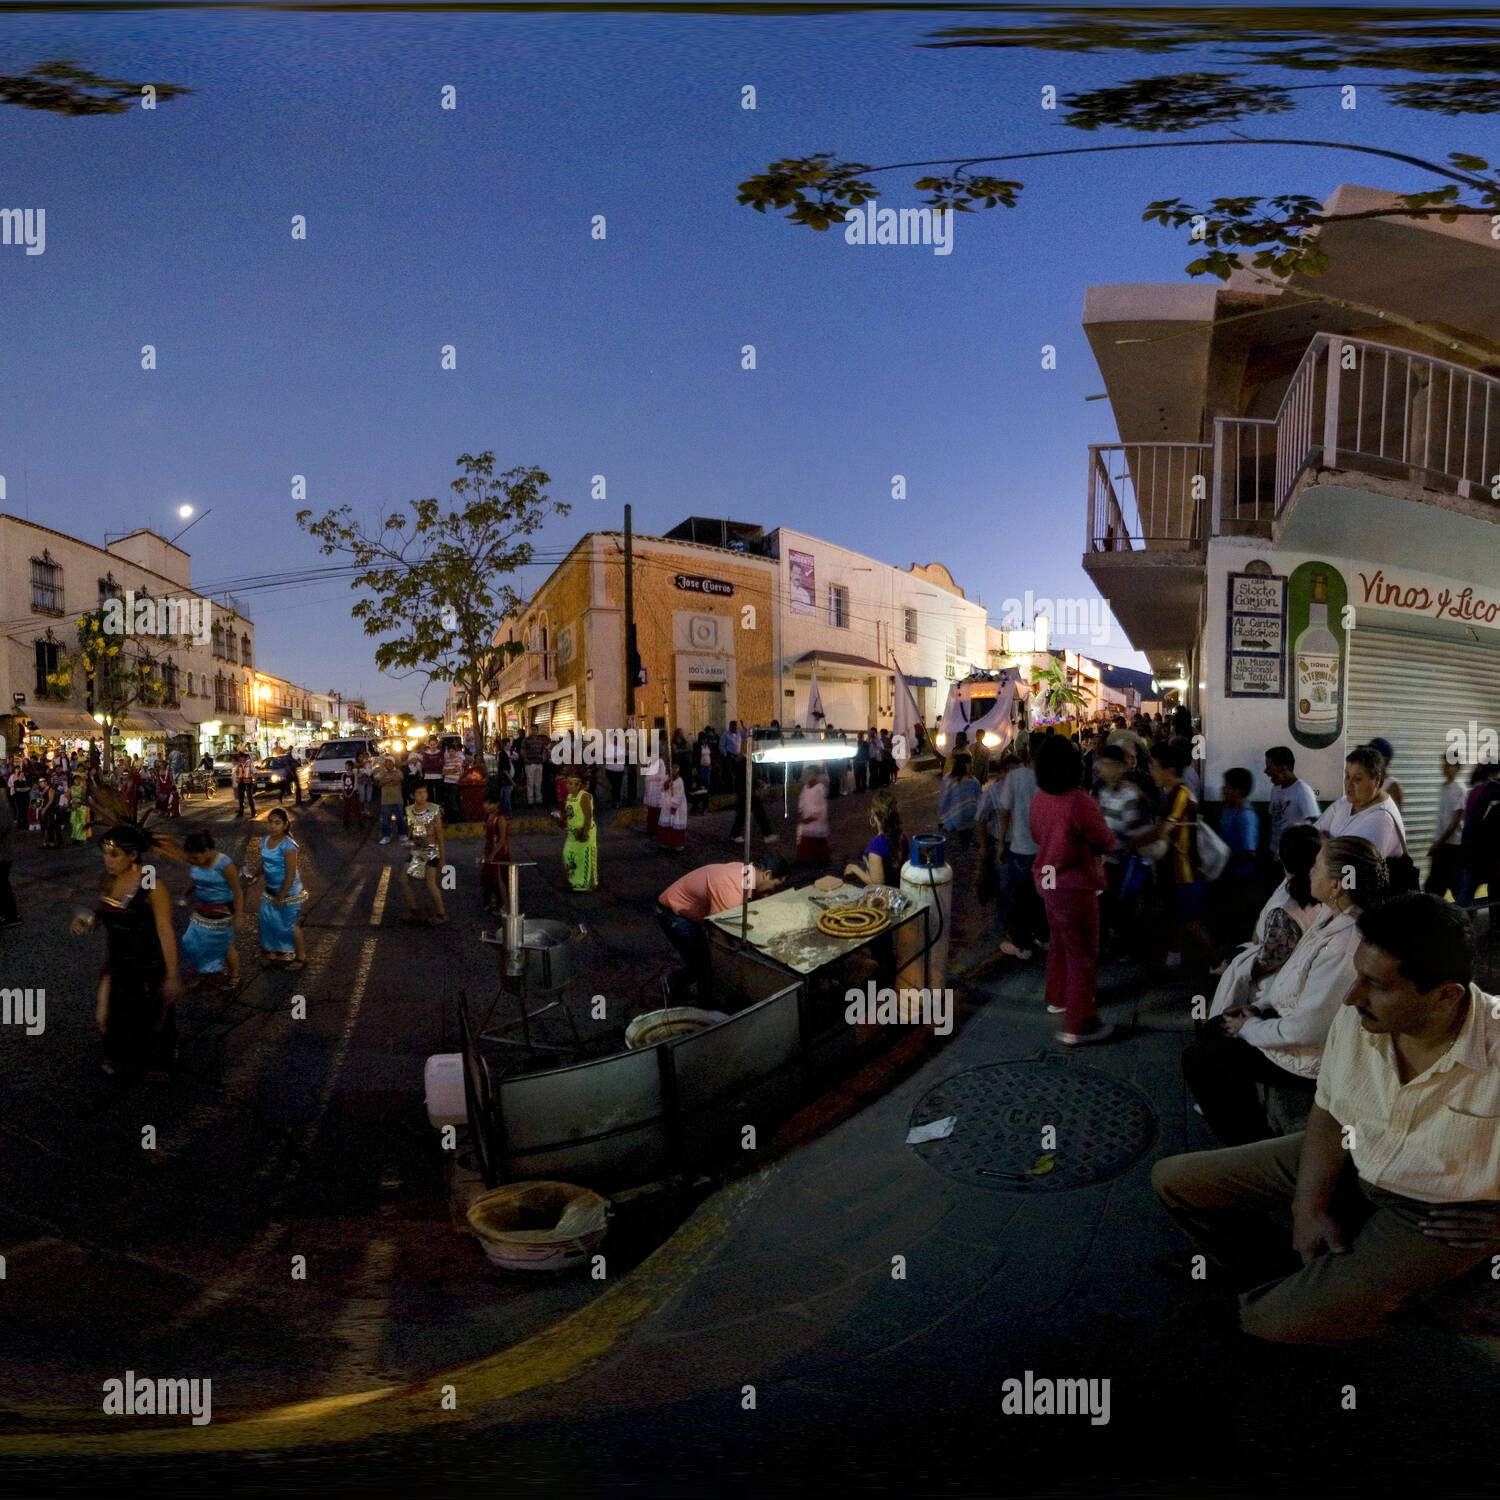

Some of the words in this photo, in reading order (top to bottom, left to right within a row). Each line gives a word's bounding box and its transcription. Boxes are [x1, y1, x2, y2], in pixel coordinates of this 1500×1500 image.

[1359, 570, 1433, 610] Vinos
[1435, 588, 1452, 619] y
[1249, 617, 1280, 630] Centro
